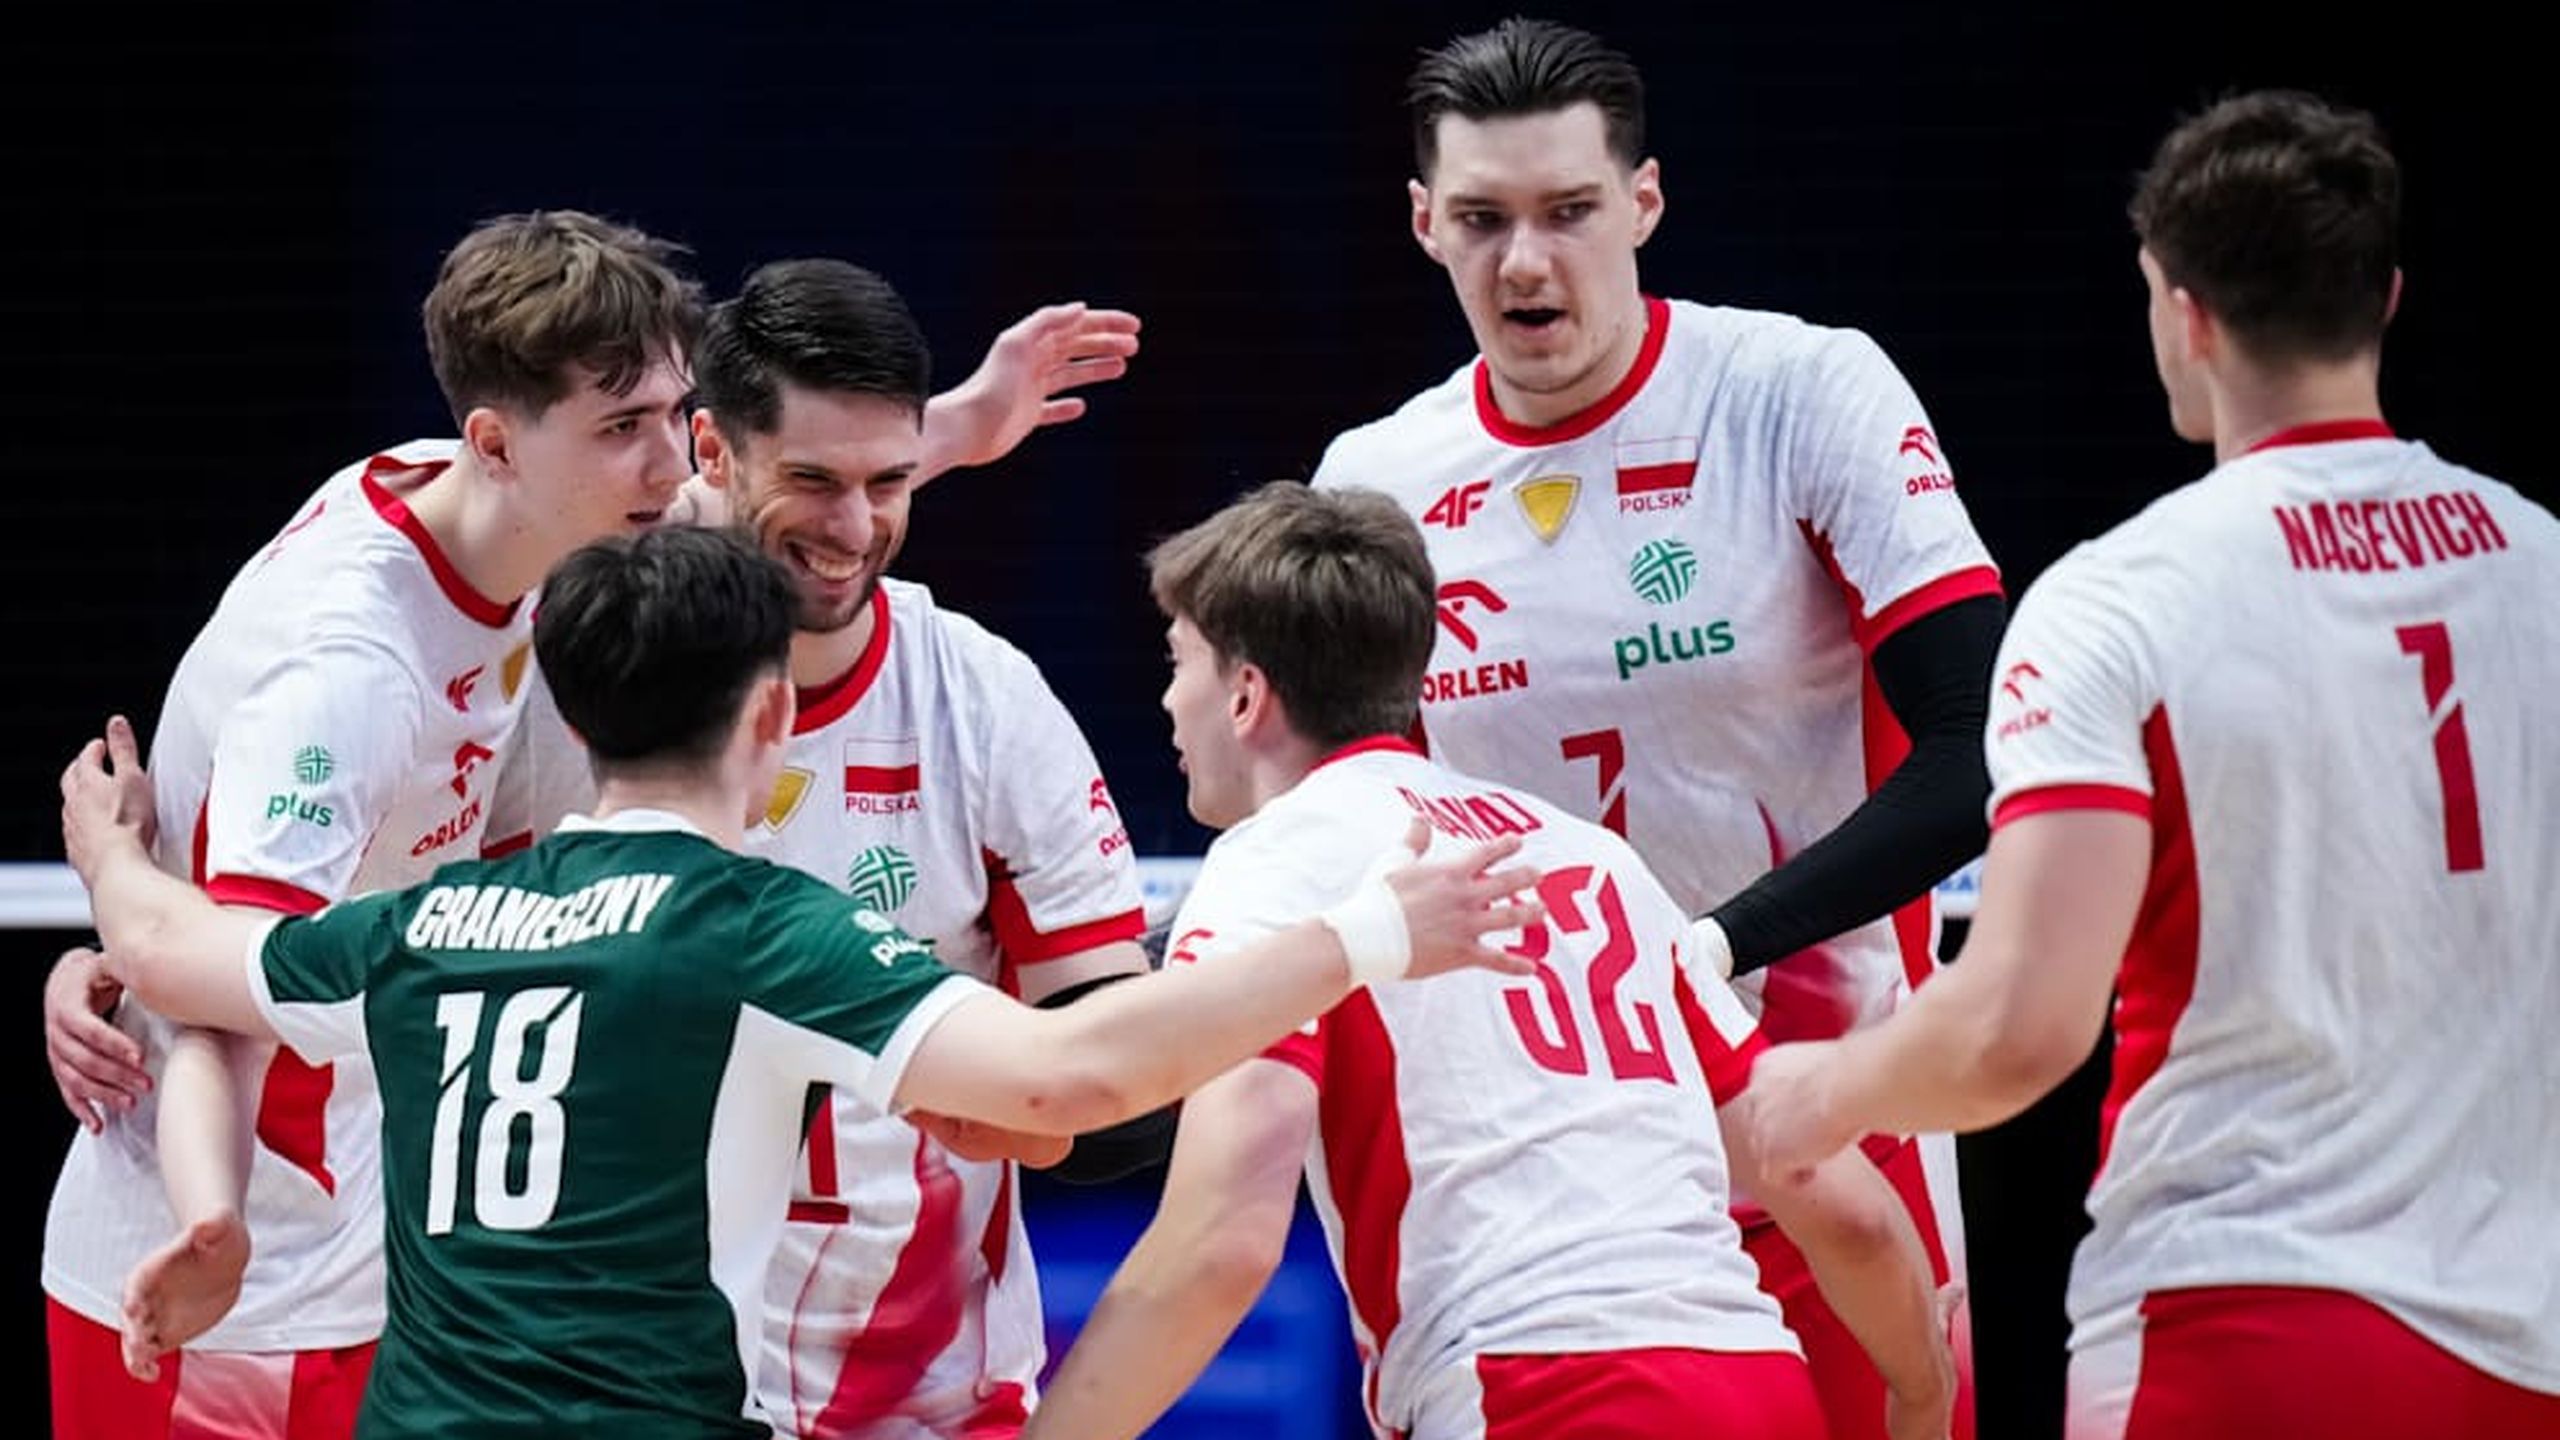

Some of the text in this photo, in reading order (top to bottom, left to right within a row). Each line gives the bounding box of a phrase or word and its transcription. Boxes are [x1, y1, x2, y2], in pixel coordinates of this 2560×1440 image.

[1423, 479, 1492, 528] 4F
[2274, 491, 2508, 573] NASEVICH
[1615, 620, 1735, 680] plus
[1423, 659, 1529, 704] ORLEN
[2395, 621, 2485, 874] 1
[266, 791, 335, 827] plus
[846, 795, 920, 815] POLSKA
[405, 873, 676, 952] GRANIECZNY
[427, 986, 584, 1237] 18
